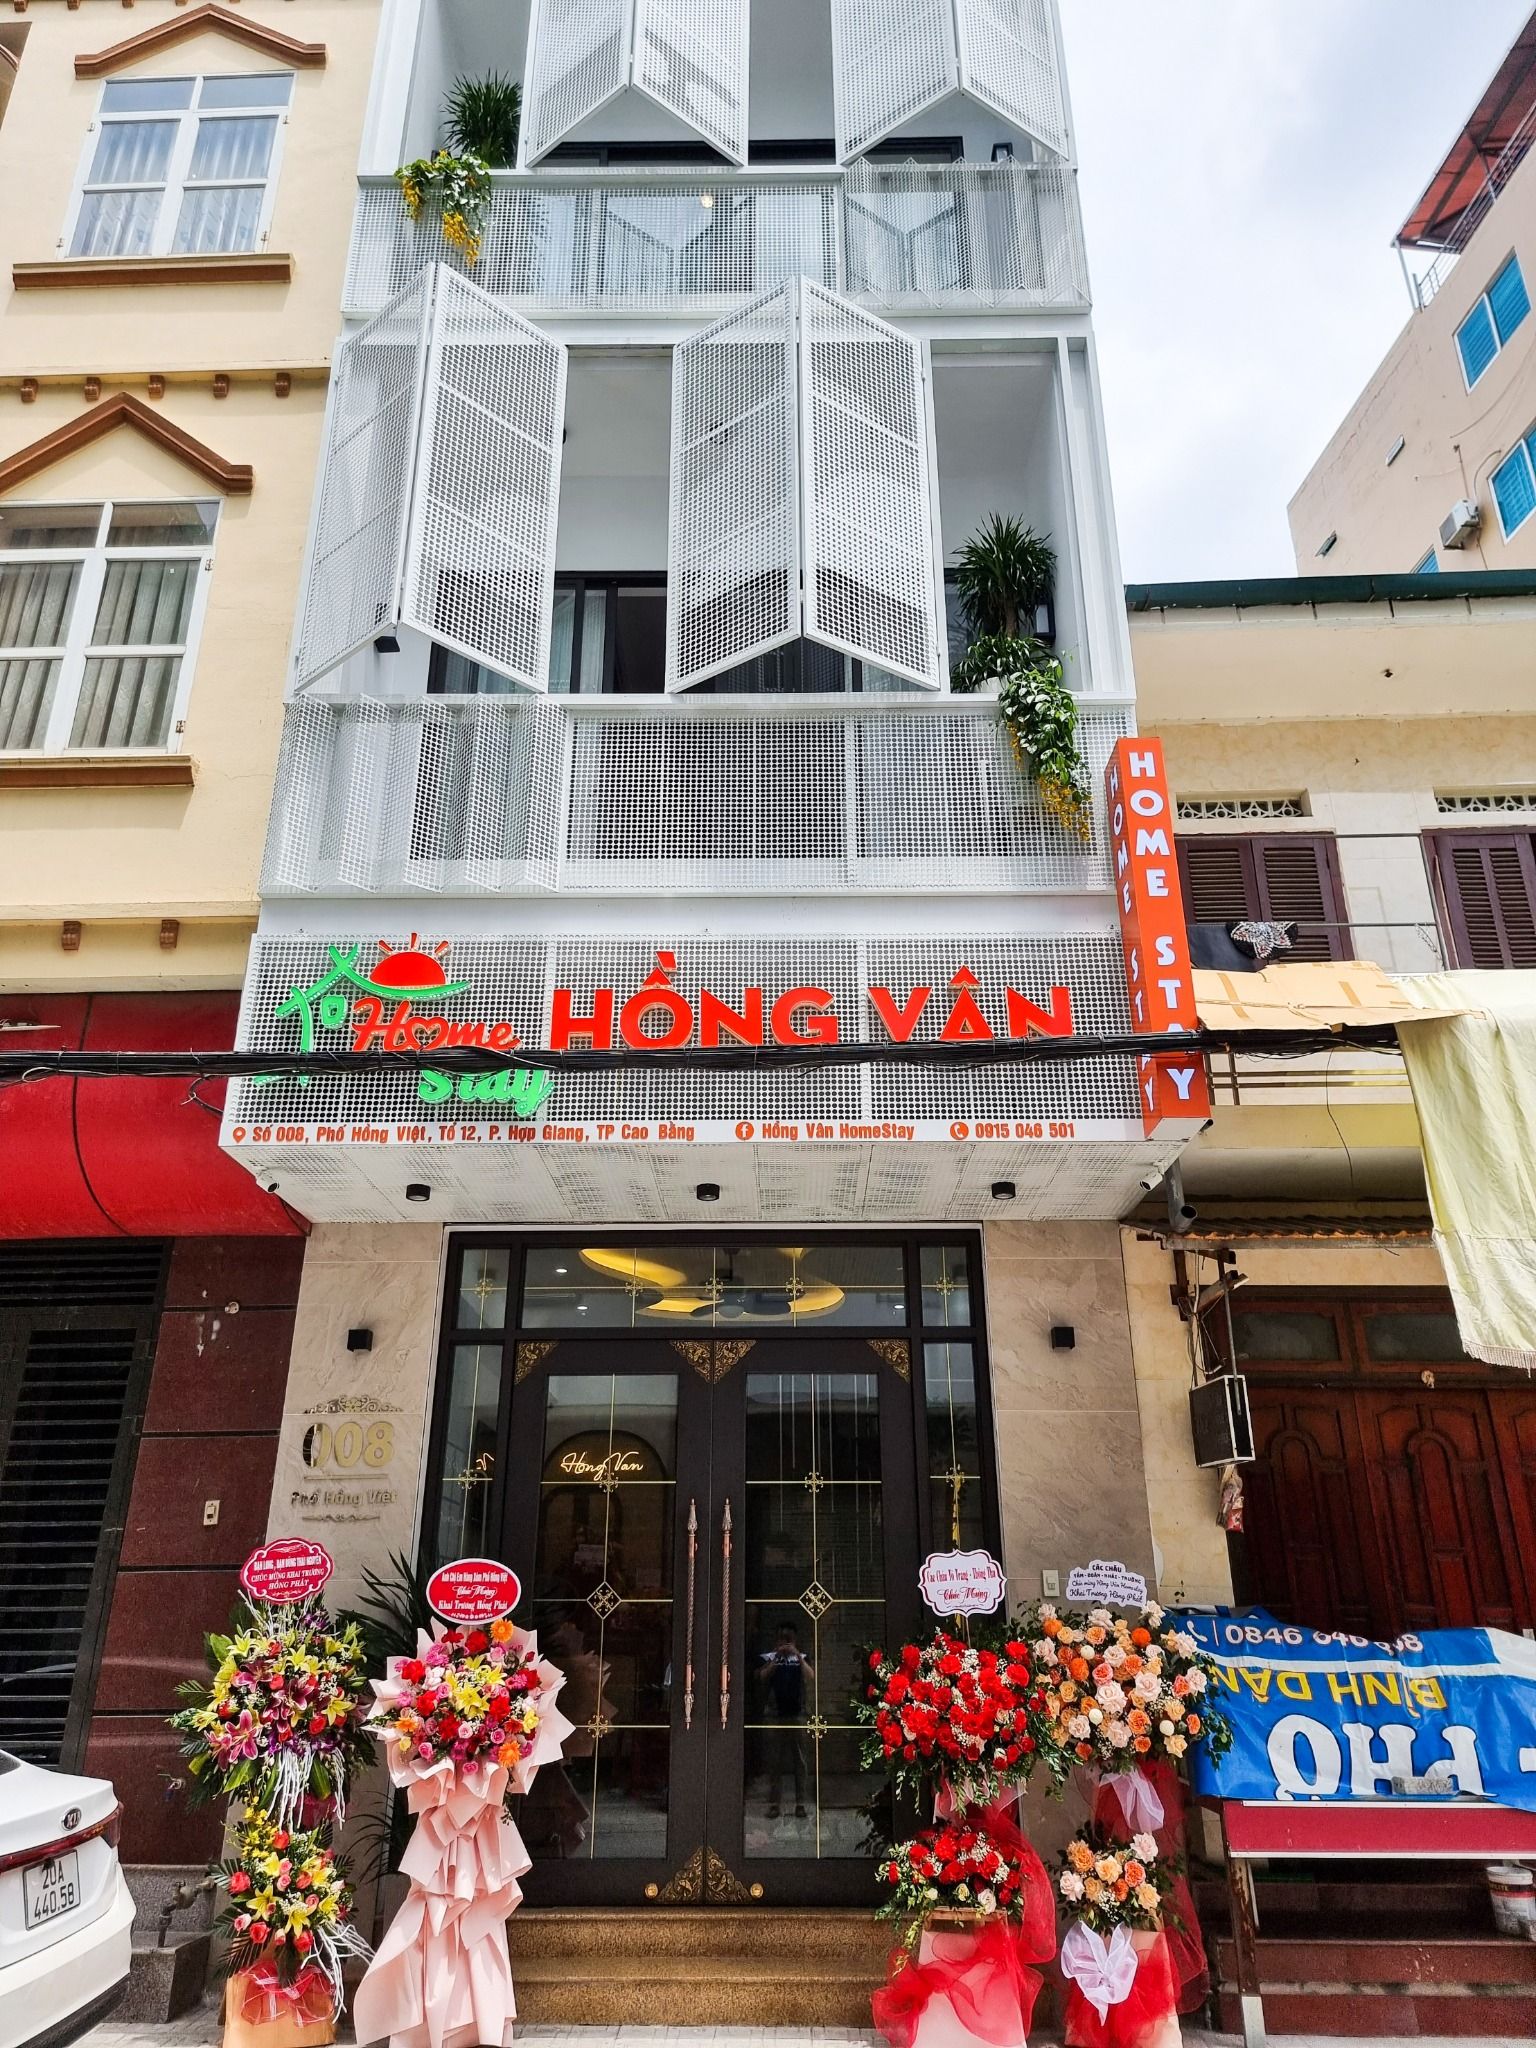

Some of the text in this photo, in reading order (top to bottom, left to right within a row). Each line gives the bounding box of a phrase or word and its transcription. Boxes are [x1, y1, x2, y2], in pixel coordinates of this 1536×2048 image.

[1109, 764, 1132, 914] HOME
[1128, 751, 1170, 898] HOME
[550, 951, 1074, 1050] HỒNG VÂN
[252, 1124, 273, 1142] Số
[276, 1126, 309, 1144] 008,
[316, 1124, 347, 1142] Phố
[351, 1124, 389, 1144] Hồng
[460, 1126, 481, 1142] 12,
[489, 1126, 501, 1140] P.
[508, 1125, 536, 1142] Hợp
[543, 1125, 590, 1142] Giang,
[597, 1124, 615, 1140] TP
[621, 1124, 648, 1140] Cao
[658, 1121, 695, 1142] Bằng
[806, 1123, 834, 1139] Vân
[839, 1122, 915, 1141] HomeStay
[975, 1122, 1075, 1138] 0915 046 501
[303, 1421, 395, 1468] 008
[1225, 1623, 1303, 1646] 0846
[1327, 1671, 1449, 1719] BÌNH
[42, 1860, 64, 1889] 20A
[34, 1882, 75, 1920] 440.58
